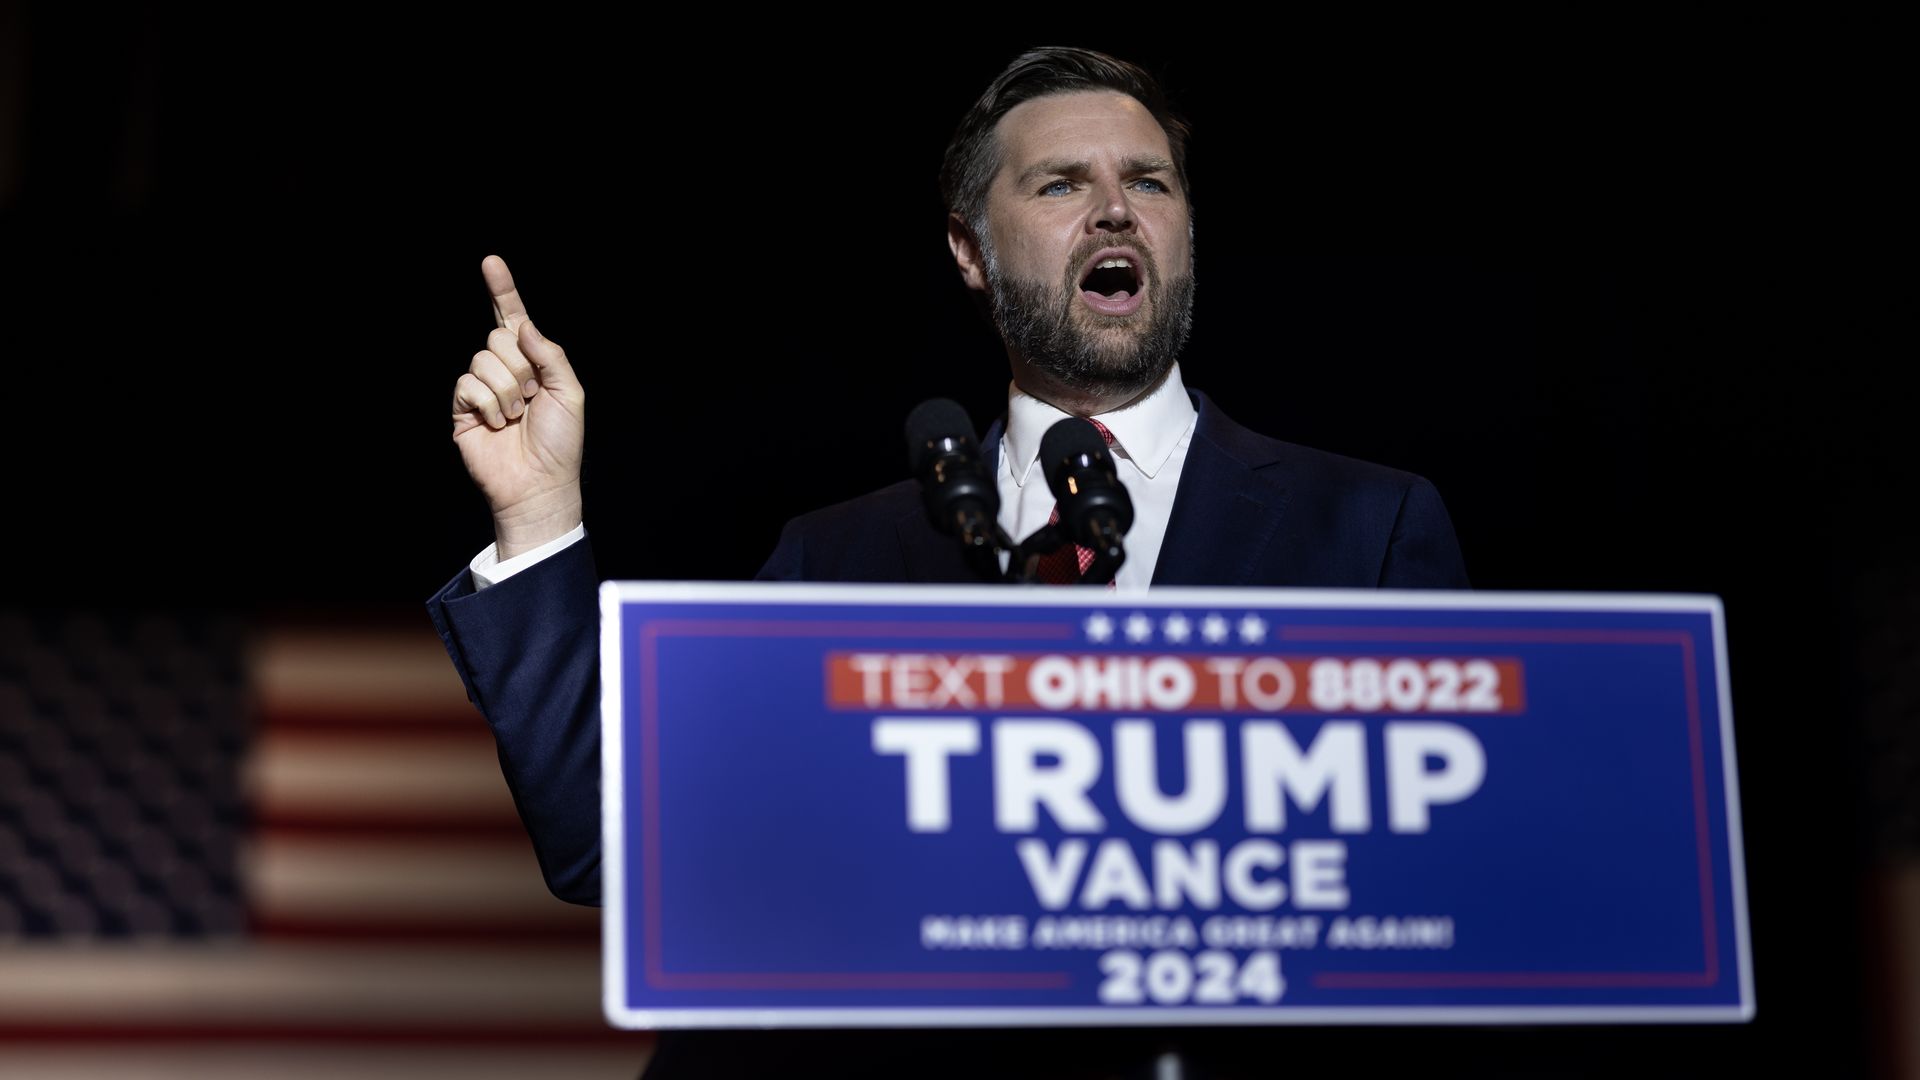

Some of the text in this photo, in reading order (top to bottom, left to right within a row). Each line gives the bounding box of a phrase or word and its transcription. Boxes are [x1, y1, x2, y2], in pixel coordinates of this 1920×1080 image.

[852, 655, 1502, 712] TEXT OHIO TO 88022
[872, 719, 1488, 834] TRUMP
[1017, 839, 1350, 911] VANCE
[921, 915, 1028, 950] MAKE
[1032, 915, 1198, 950] AMERICA
[1202, 915, 1322, 950] GREAT
[1098, 951, 1285, 1004] 2024
